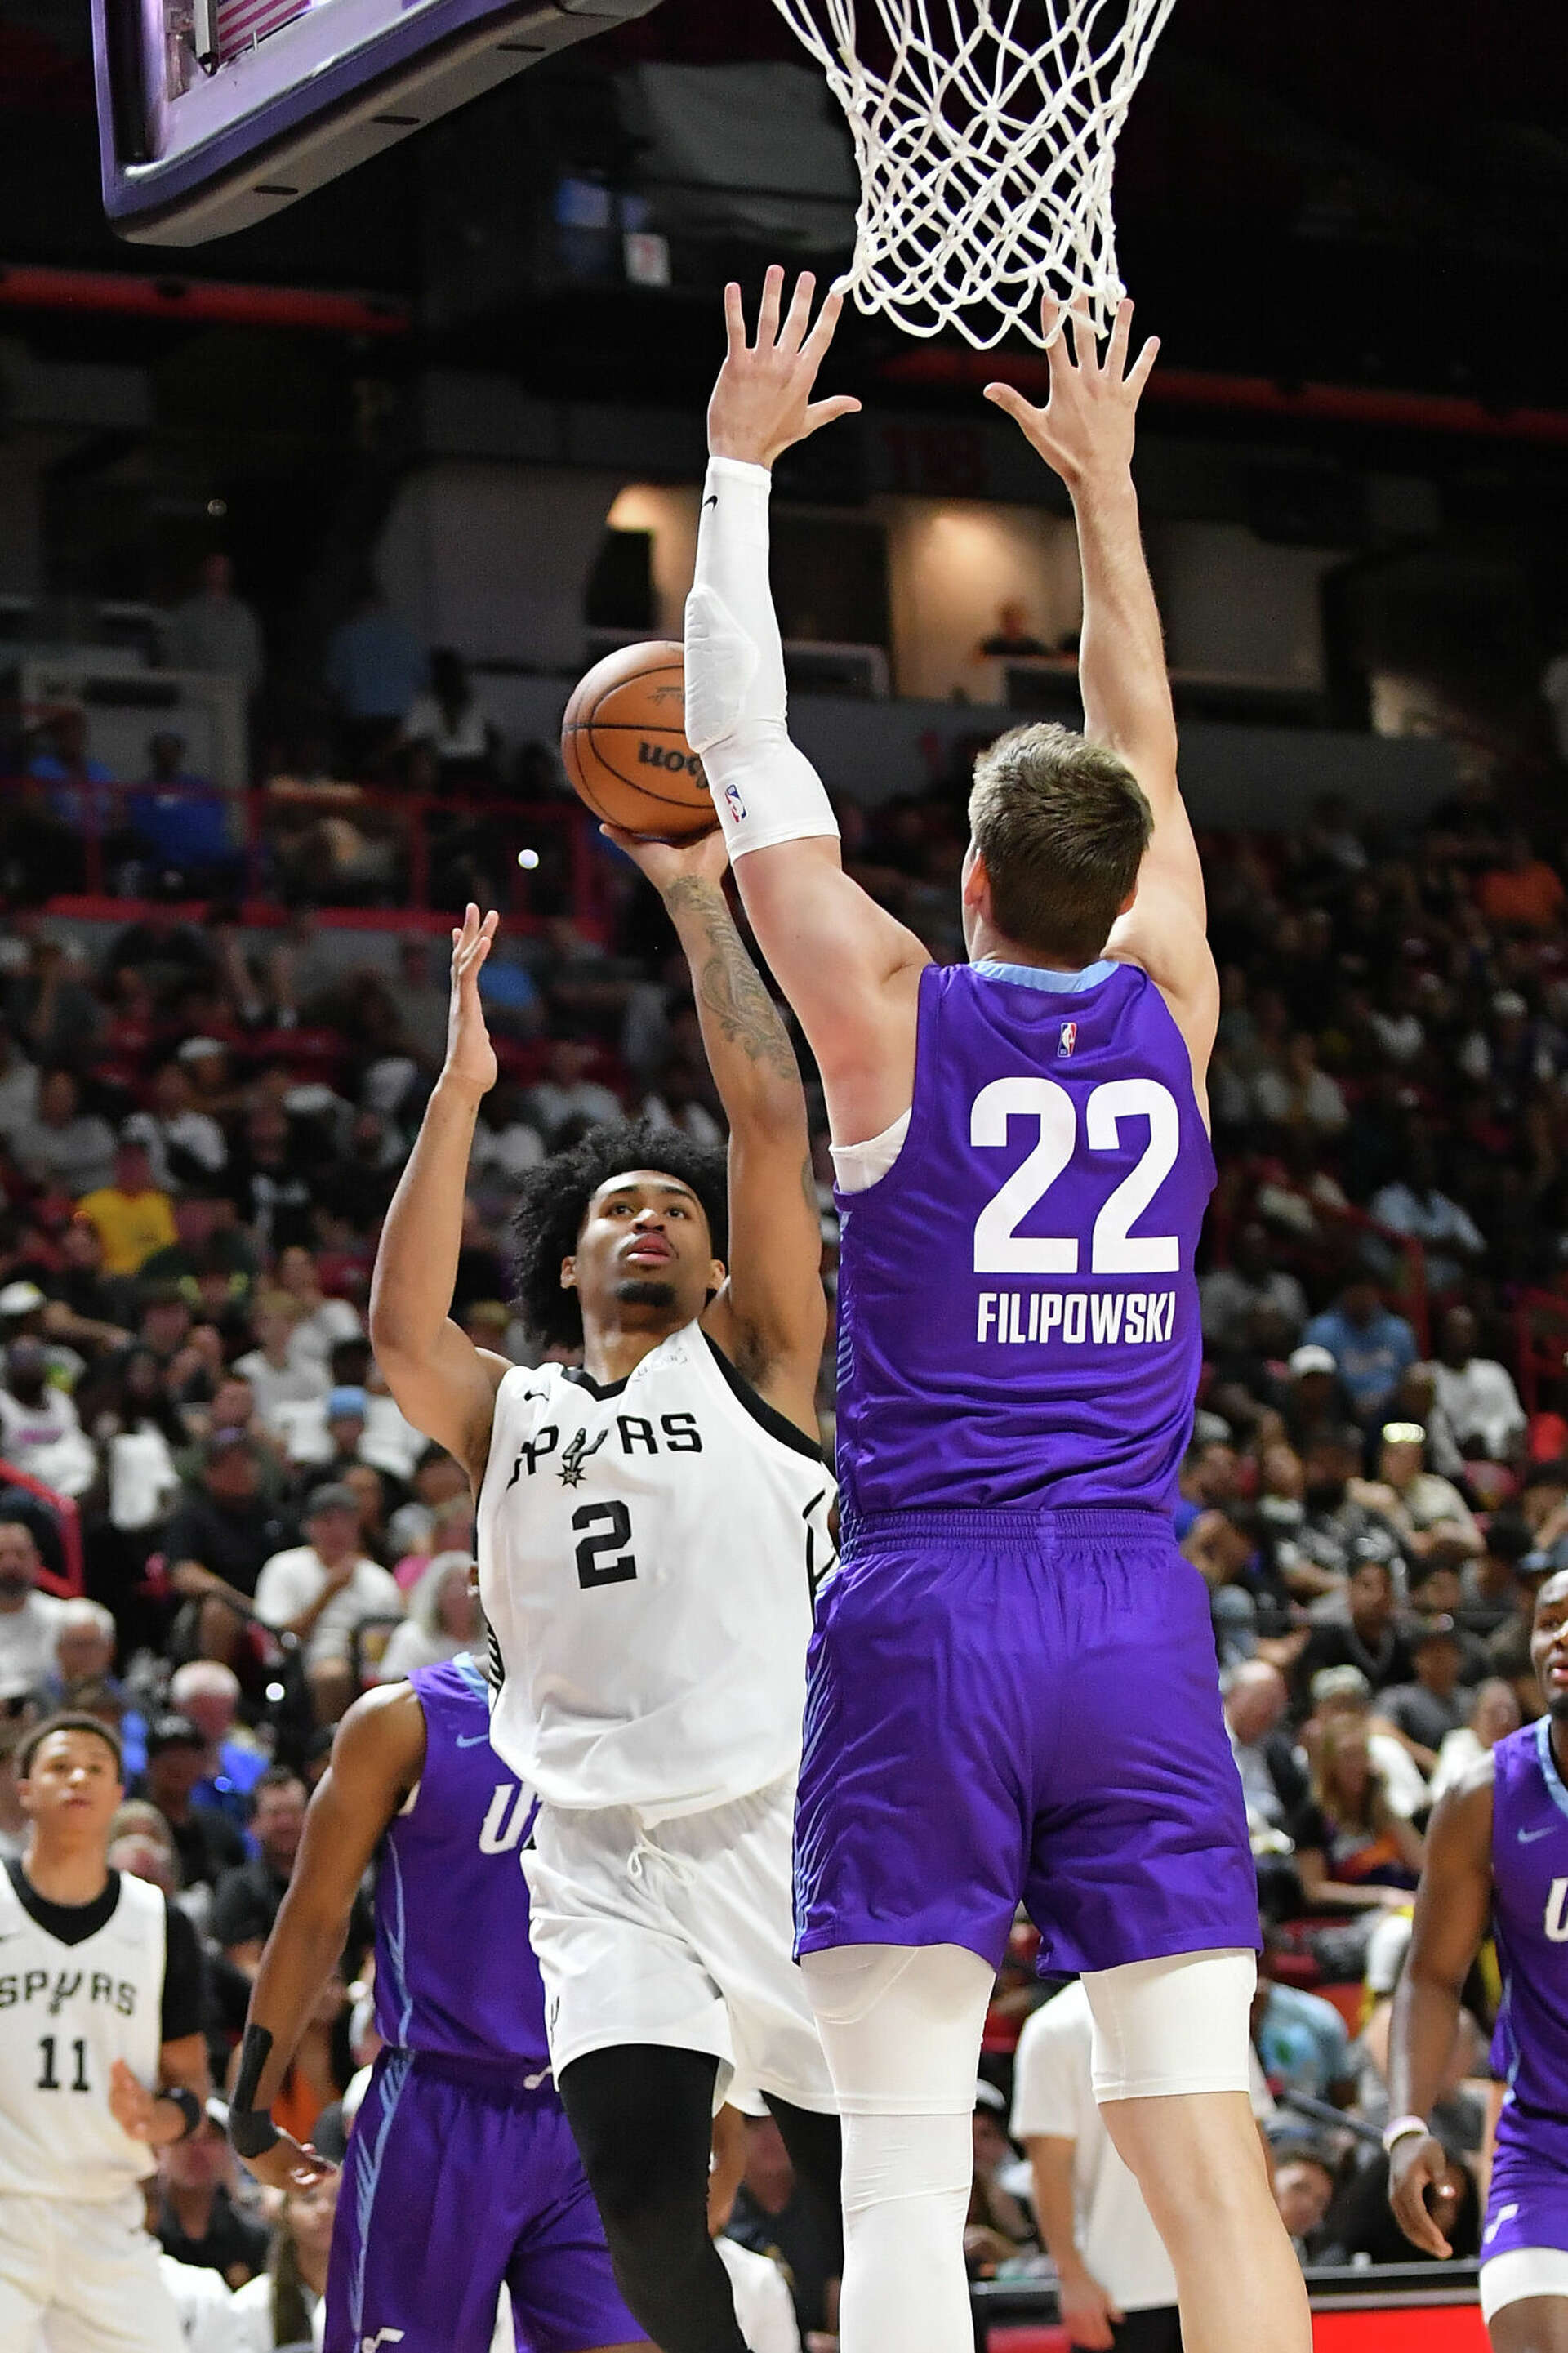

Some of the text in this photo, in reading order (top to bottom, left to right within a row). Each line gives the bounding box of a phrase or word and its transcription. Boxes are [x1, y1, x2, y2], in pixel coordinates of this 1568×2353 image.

[970, 1076, 1180, 1274] 22
[977, 1290, 1176, 1344] FILIPOWSKI
[572, 1500, 637, 1589] 2
[0, 1970, 136, 2017] SPURS
[38, 2036, 90, 2092] 11
